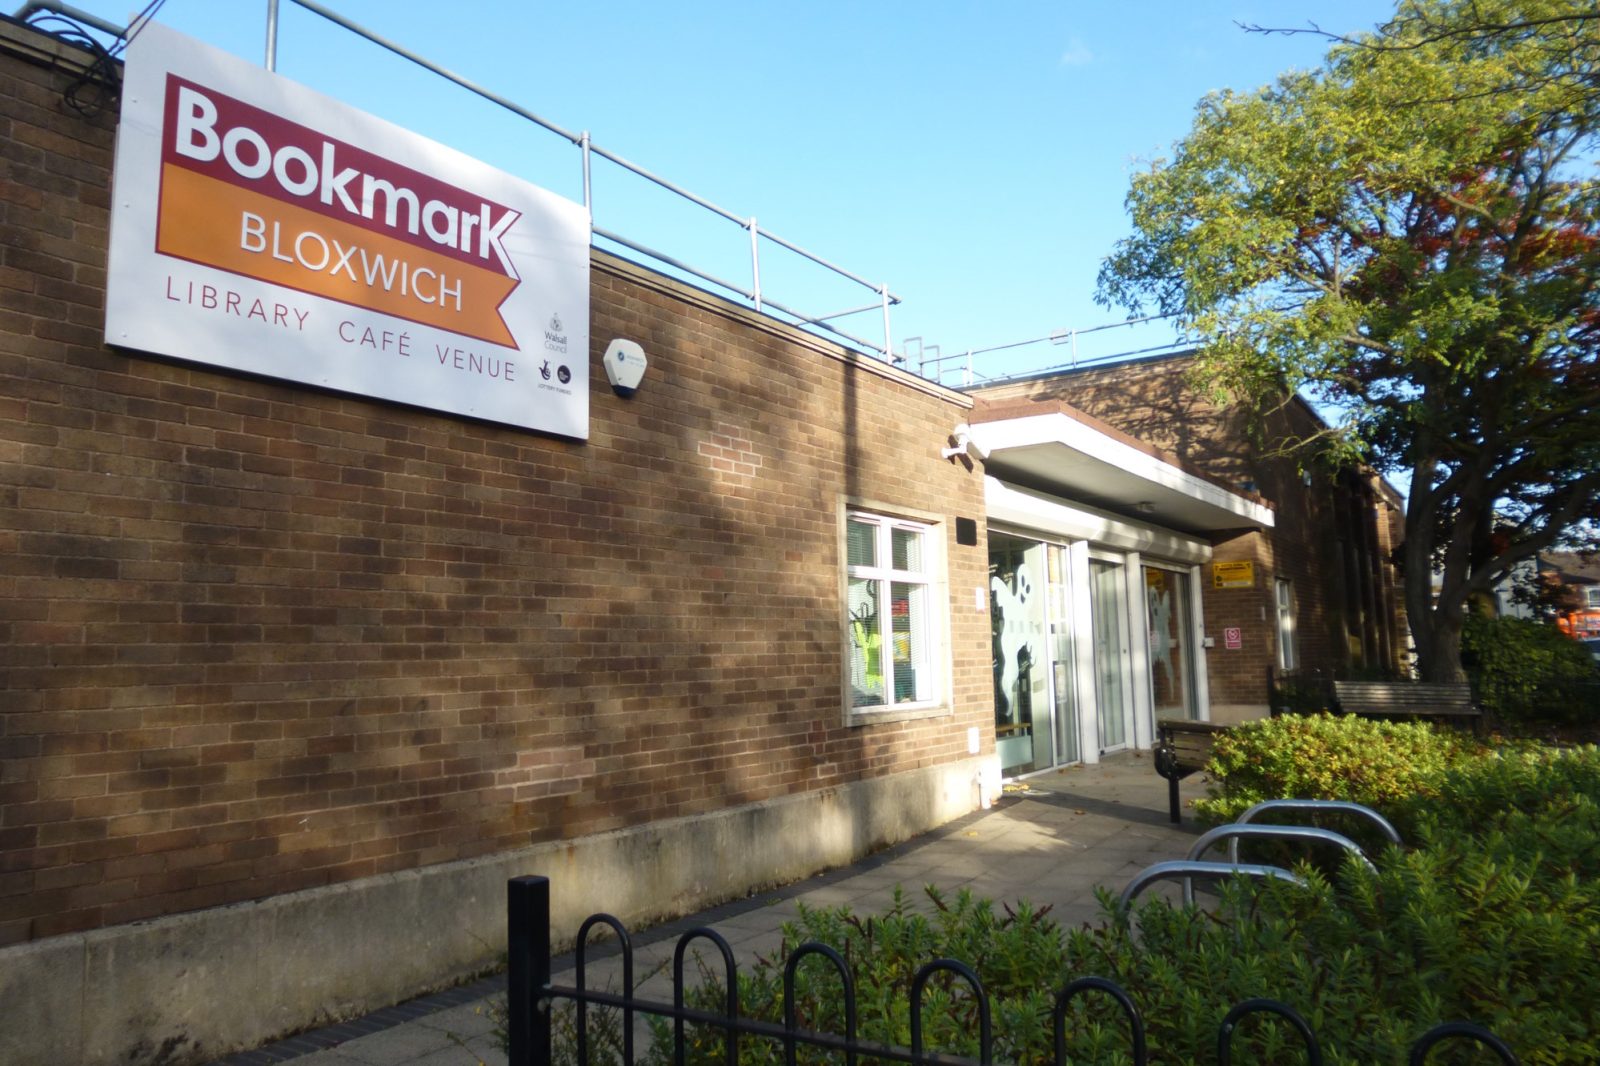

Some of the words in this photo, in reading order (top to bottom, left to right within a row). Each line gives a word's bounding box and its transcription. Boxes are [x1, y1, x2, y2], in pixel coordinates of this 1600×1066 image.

[241, 211, 462, 312] BLOXWICH
[167, 275, 310, 331] LIBRARY
[339, 321, 411, 357] CAFÉ
[436, 345, 515, 382] VENUE
[544, 331, 567, 344] Walsall
[544, 340, 567, 354] Council
